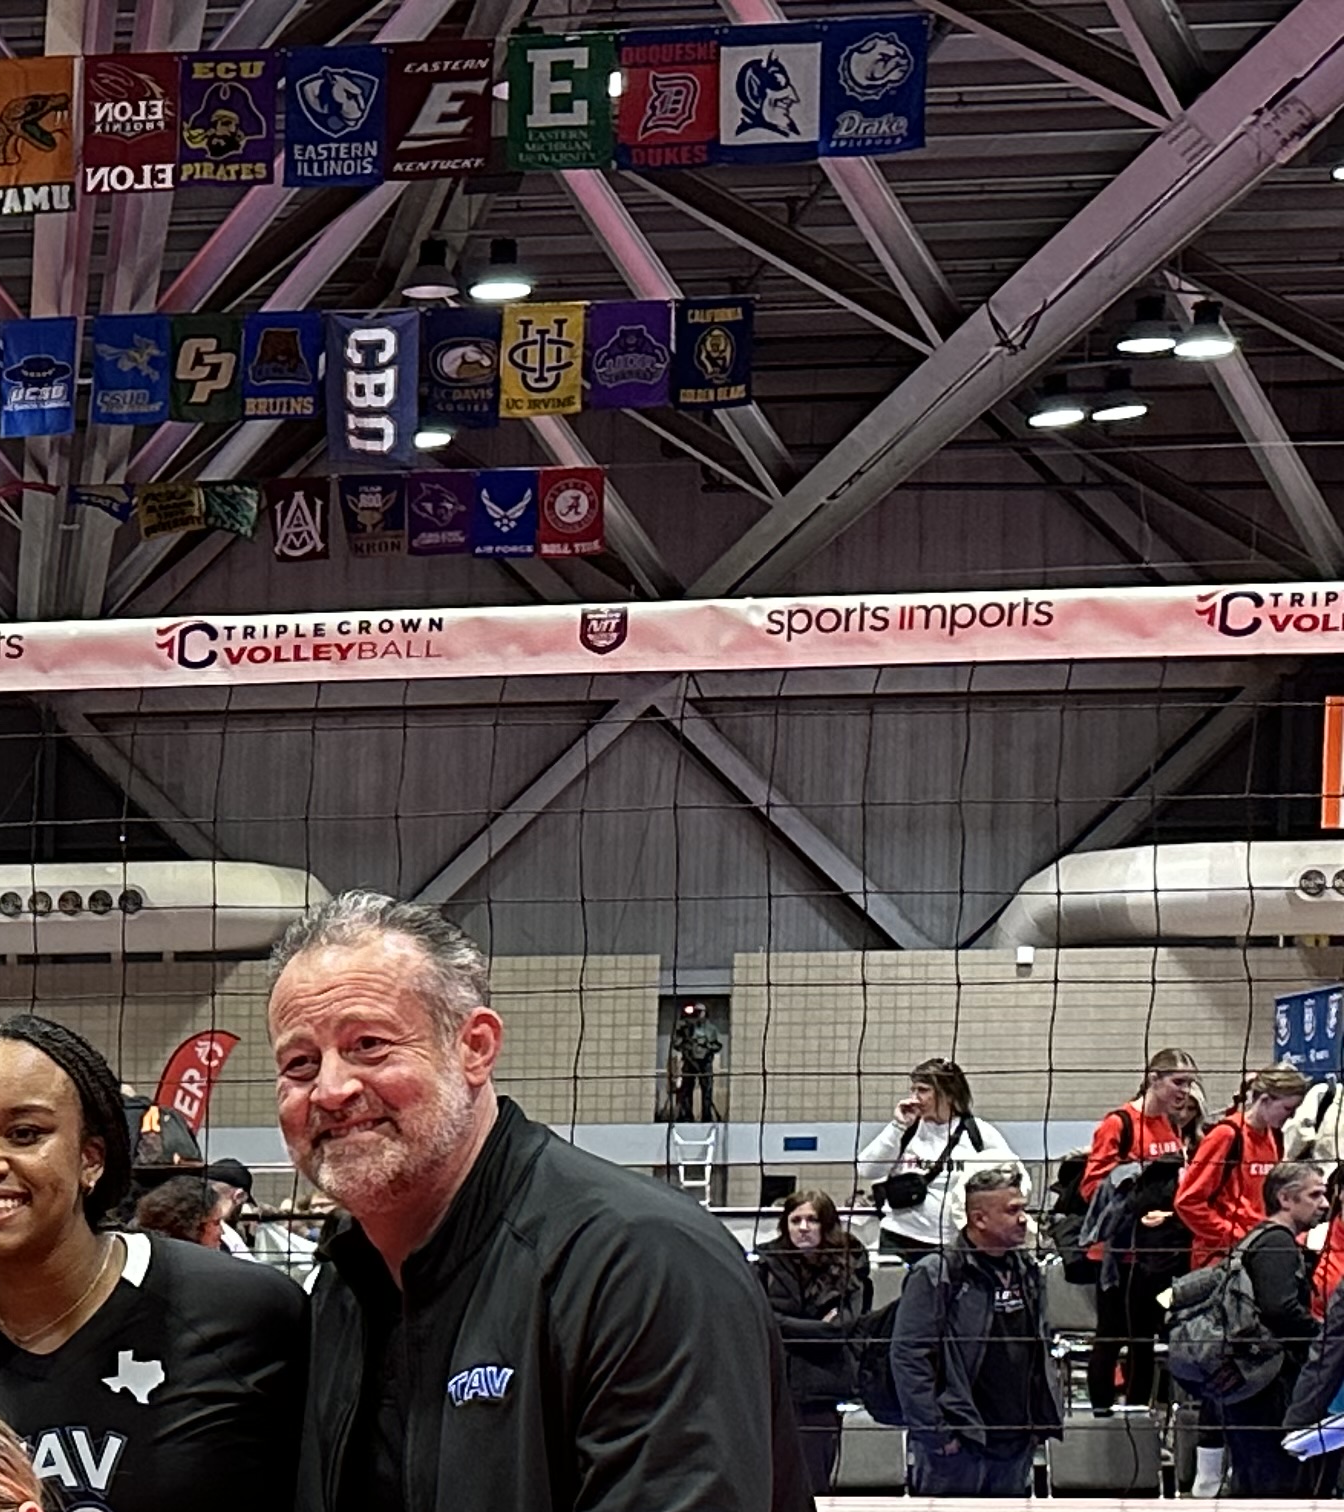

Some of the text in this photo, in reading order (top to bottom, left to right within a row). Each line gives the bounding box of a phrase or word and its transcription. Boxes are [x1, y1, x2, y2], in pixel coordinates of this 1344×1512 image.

[622, 41, 716, 65] DUQUESNE
[192, 62, 265, 79] ECU
[404, 57, 489, 73] EASTERN
[526, 47, 589, 127] E
[835, 110, 908, 137] Drake
[528, 129, 588, 141] EASTERN
[294, 141, 377, 160] EASTERN
[524, 140, 592, 152] MICHIGAN
[631, 144, 707, 166] DUKES
[392, 157, 486, 172] KENTUCKY
[518, 150, 596, 163] UNIVERSITY
[180, 163, 267, 181] PIRATES
[297, 158, 375, 177] ILLINOIS
[453, 387, 494, 400] DAVIS
[244, 397, 314, 416] BRUINS
[506, 396, 575, 411] UC IRVINE
[223, 616, 444, 641] TRIPLE CROWN
[766, 597, 1053, 642] sports imports
[1268, 613, 1344, 633] VOL
[223, 639, 442, 665] VOLLEYBALL
[447, 1364, 514, 1406] TAV
[27, 1426, 126, 1491] AV
